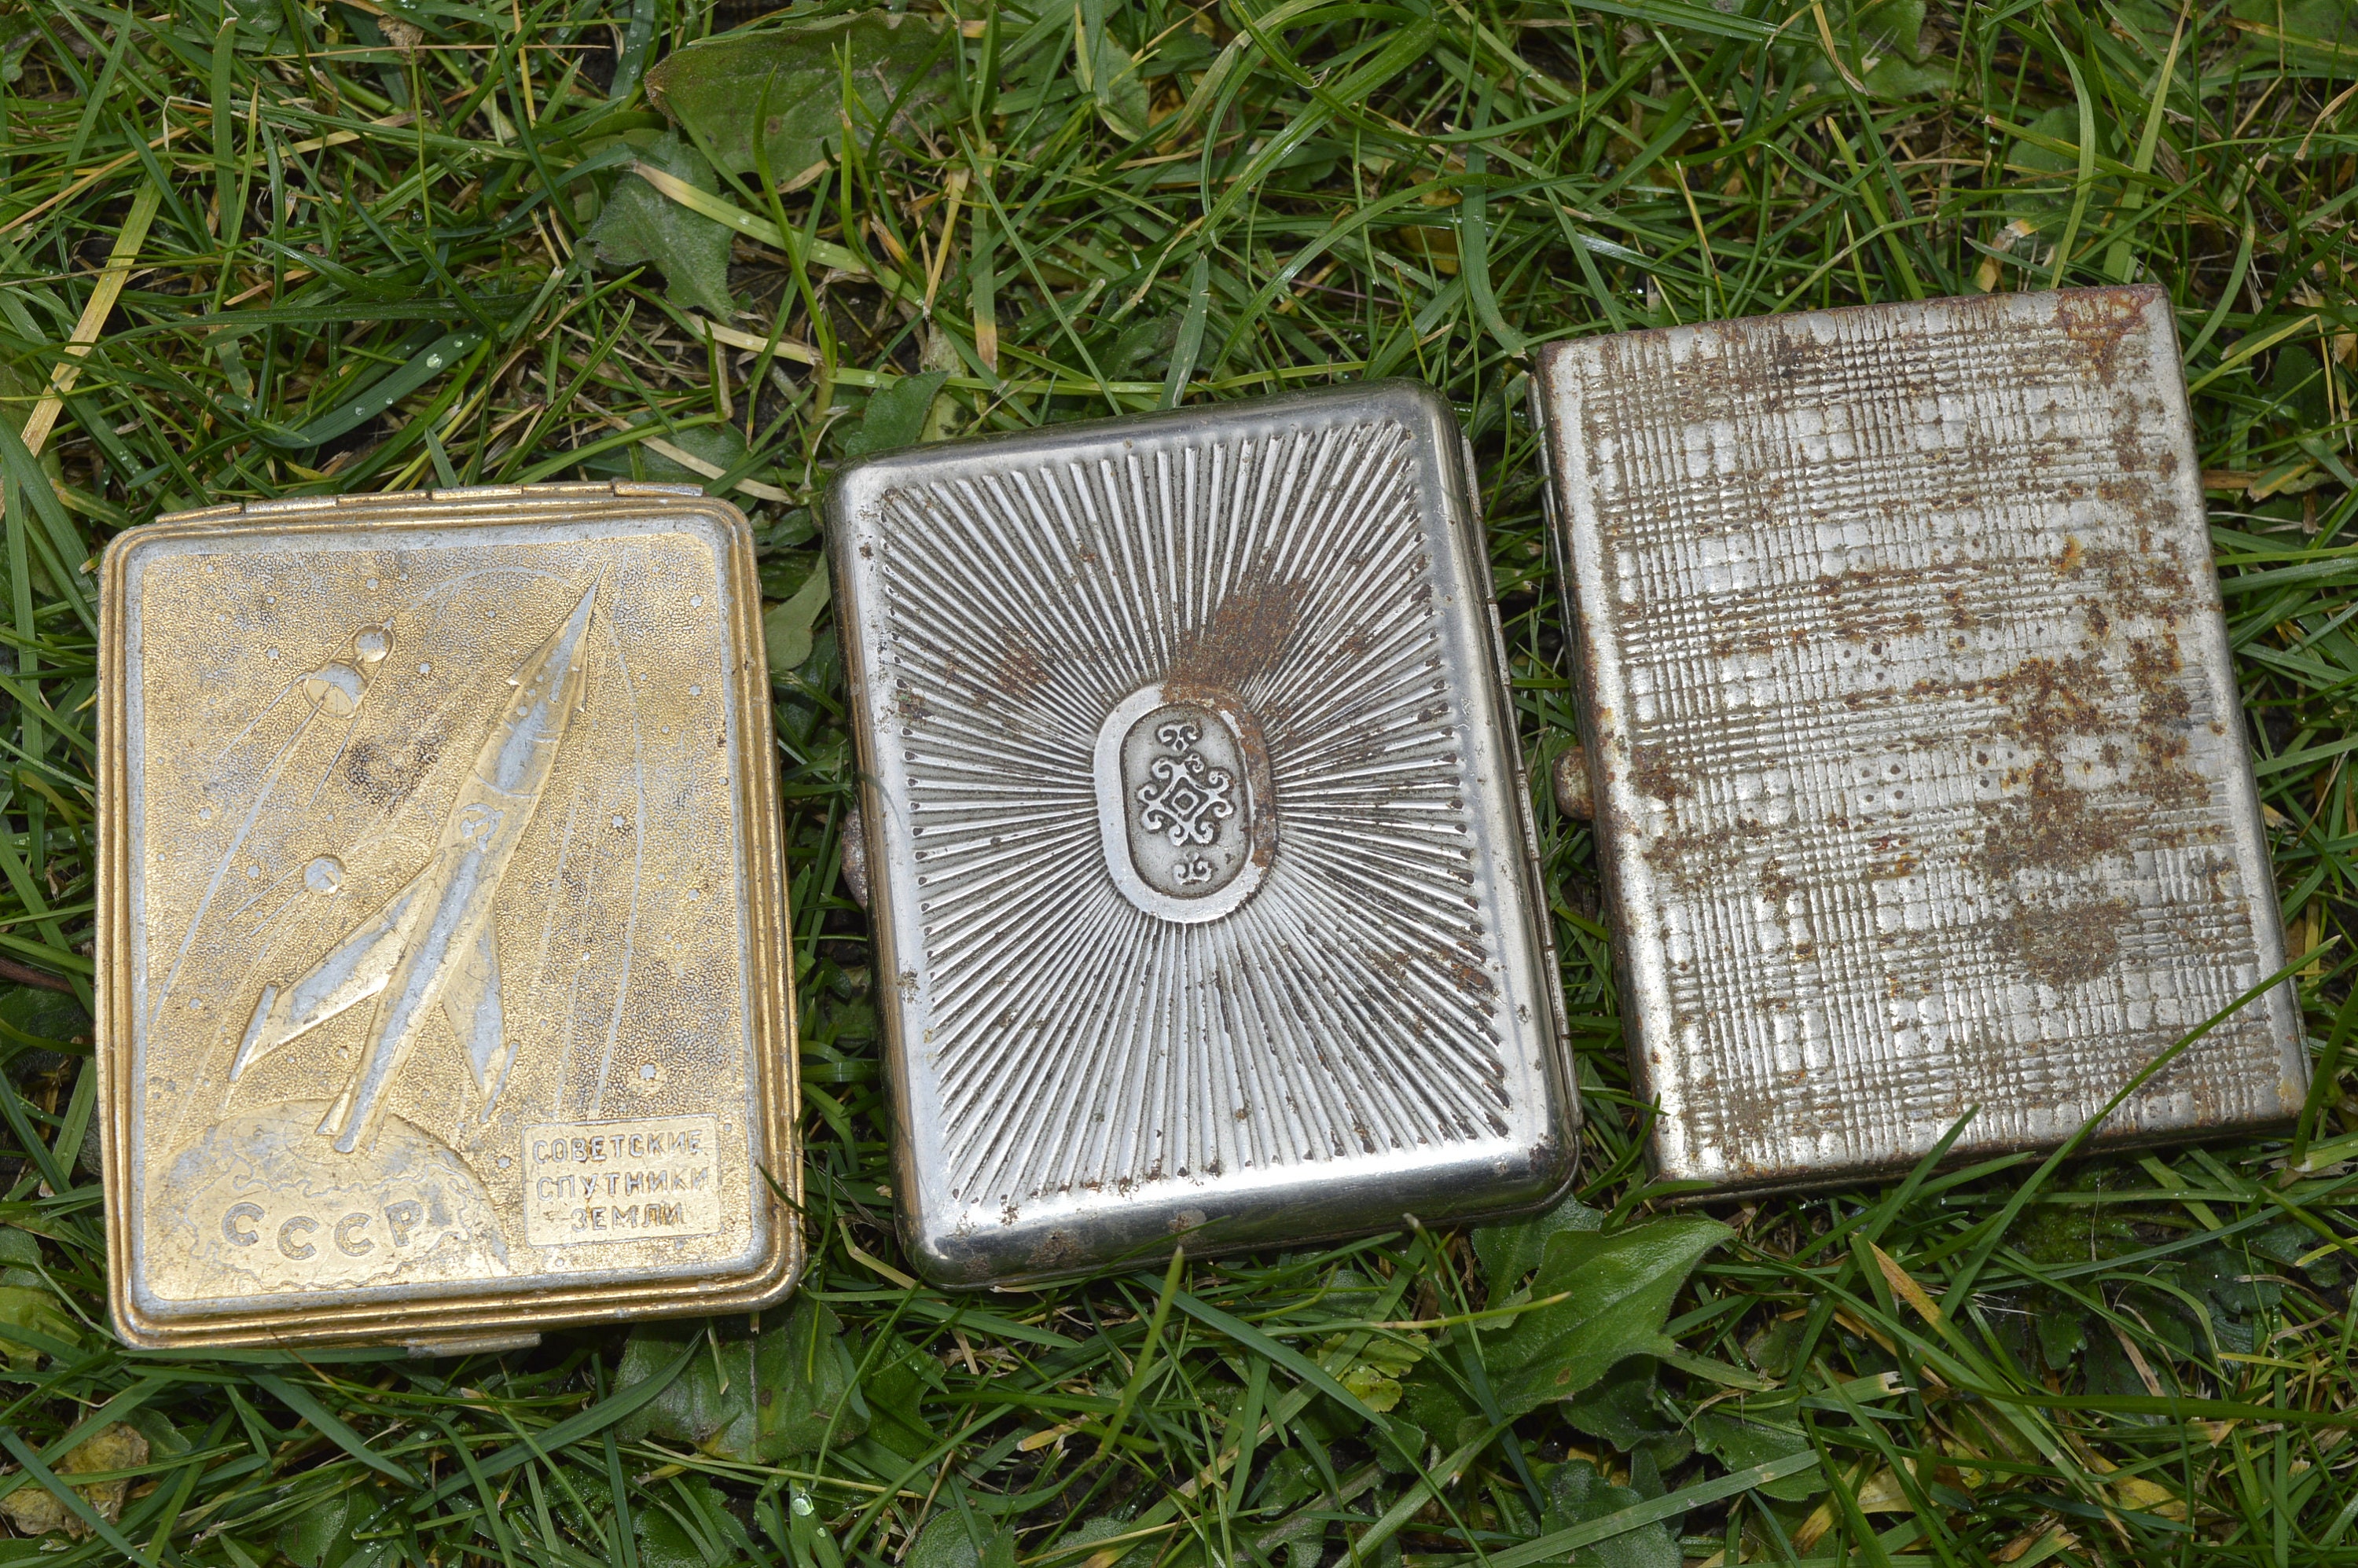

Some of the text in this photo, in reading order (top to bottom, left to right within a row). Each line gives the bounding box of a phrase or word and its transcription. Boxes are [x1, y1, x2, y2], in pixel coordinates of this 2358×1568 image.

[531, 1129, 703, 1166] СОВЕТСКИЕ
[536, 1166, 709, 1202] СПУТНИКИ
[221, 1199, 424, 1261] СССР
[571, 1201, 686, 1233] ЗЕМЛИ
